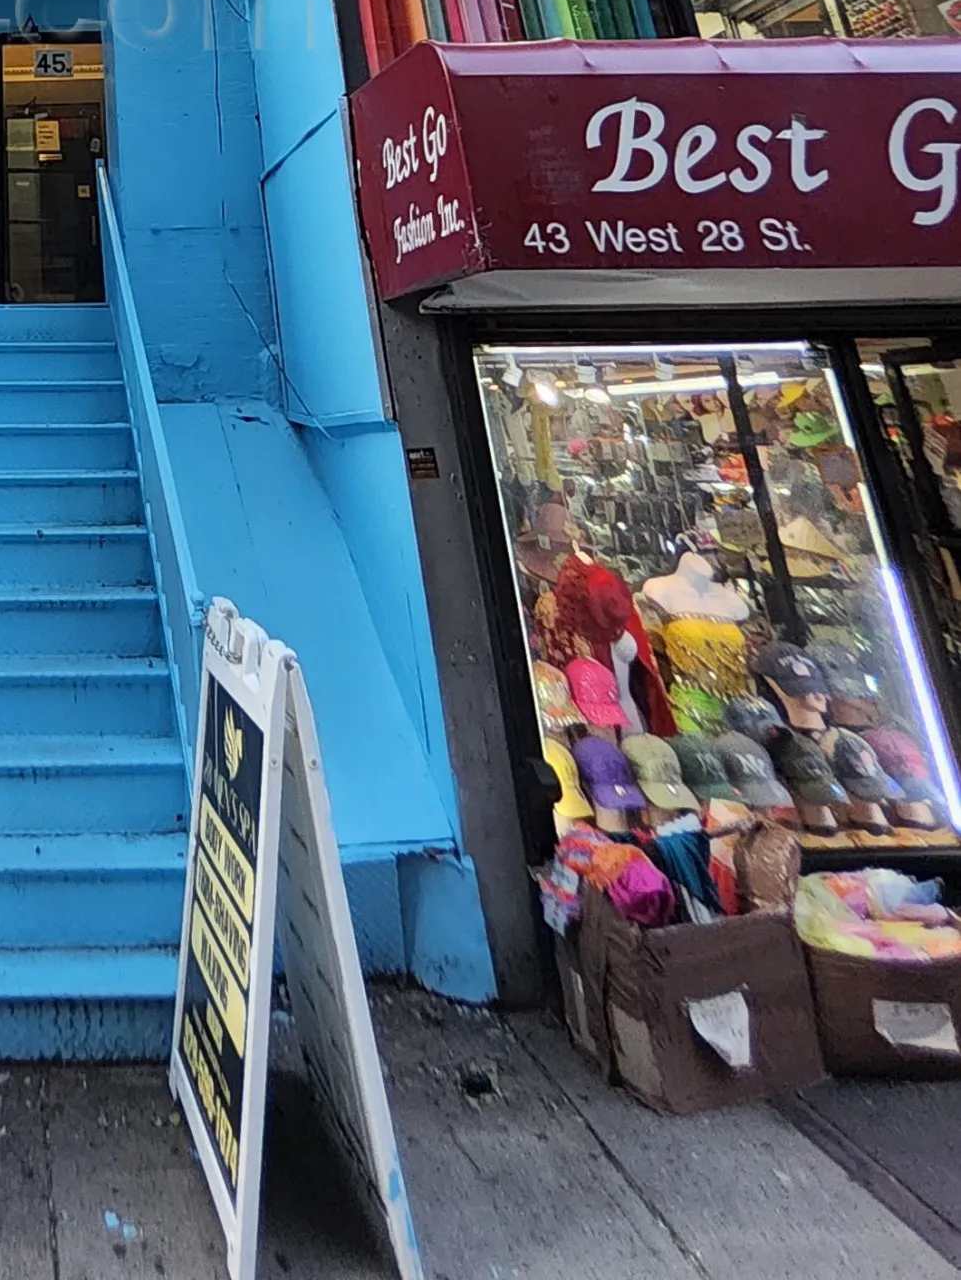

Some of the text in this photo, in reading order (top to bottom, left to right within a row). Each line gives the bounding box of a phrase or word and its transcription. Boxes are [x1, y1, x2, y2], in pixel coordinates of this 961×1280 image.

[382, 105, 447, 190] Best Go
[585, 95, 830, 194] Best
[393, 194, 466, 265] Fashion Inc.
[523, 217, 814, 255] 43 West 28 St.
